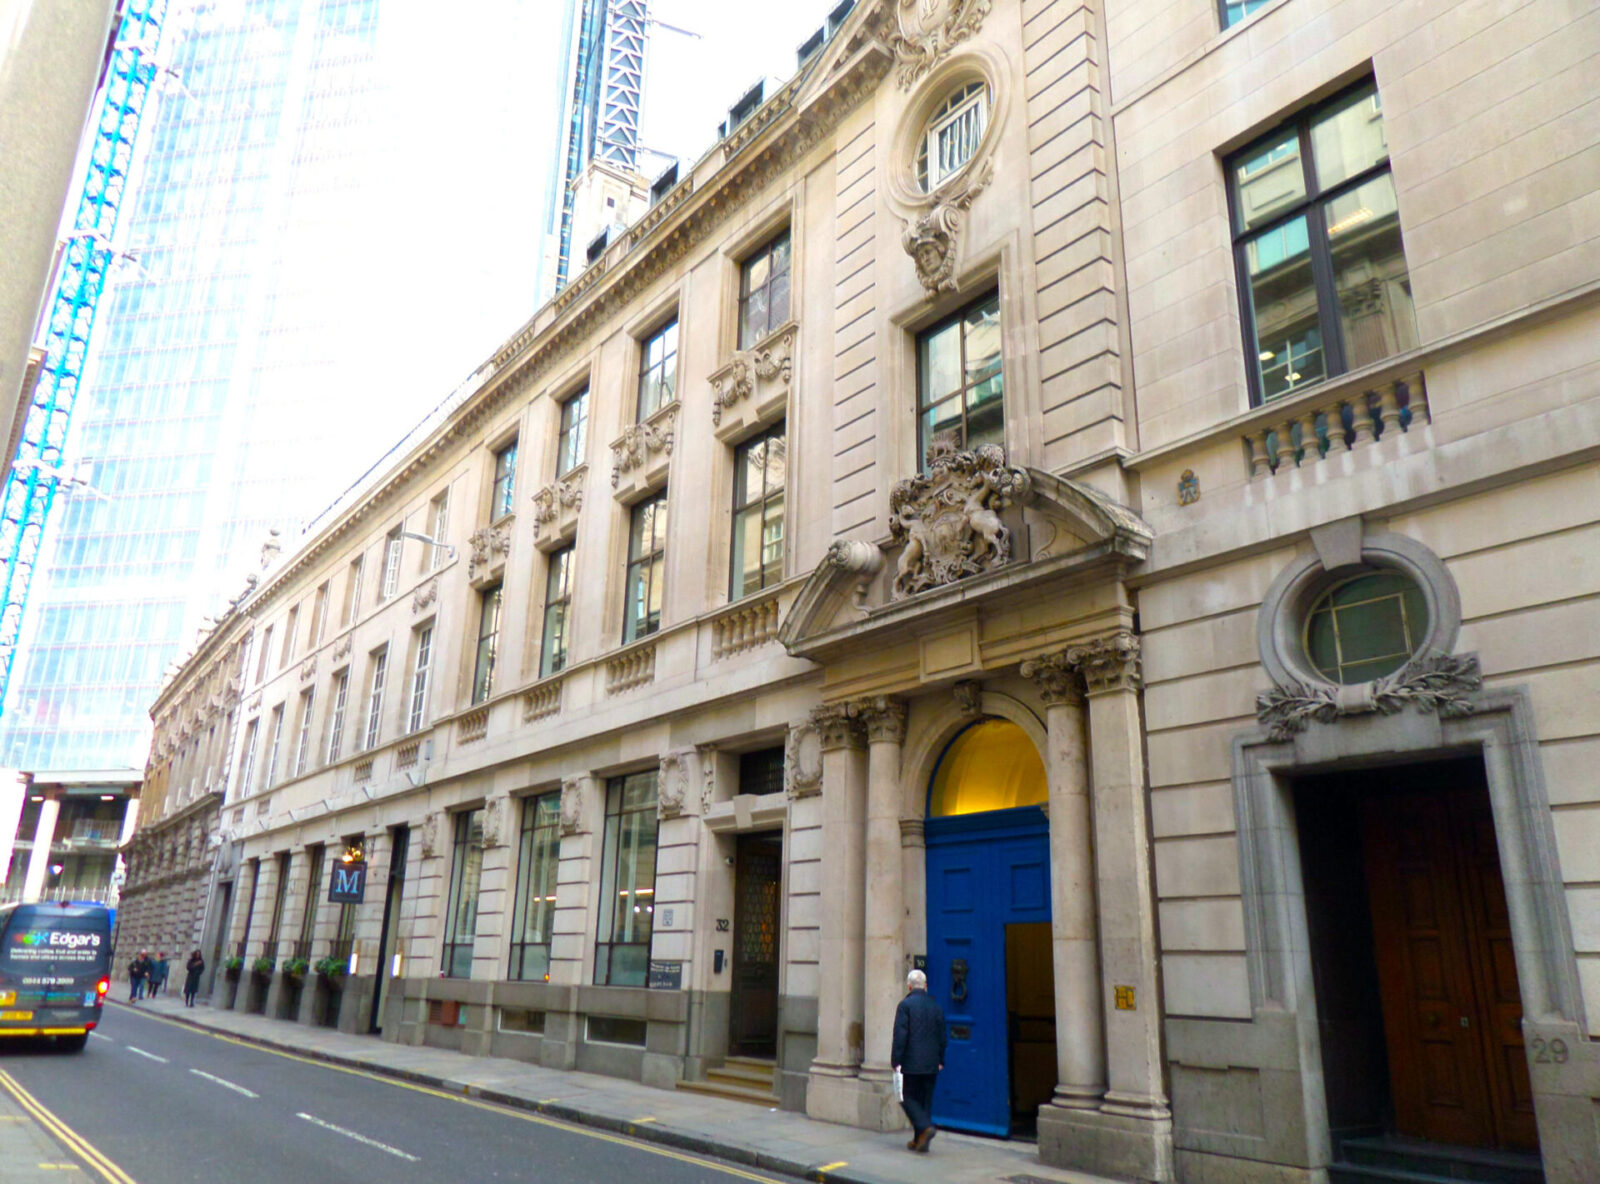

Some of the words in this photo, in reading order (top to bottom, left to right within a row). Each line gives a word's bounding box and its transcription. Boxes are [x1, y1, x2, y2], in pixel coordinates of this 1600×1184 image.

[335, 869, 361, 894] M
[715, 918, 729, 932] 32
[49, 931, 100, 948] Edgar's
[1532, 1037, 1570, 1065] 29
